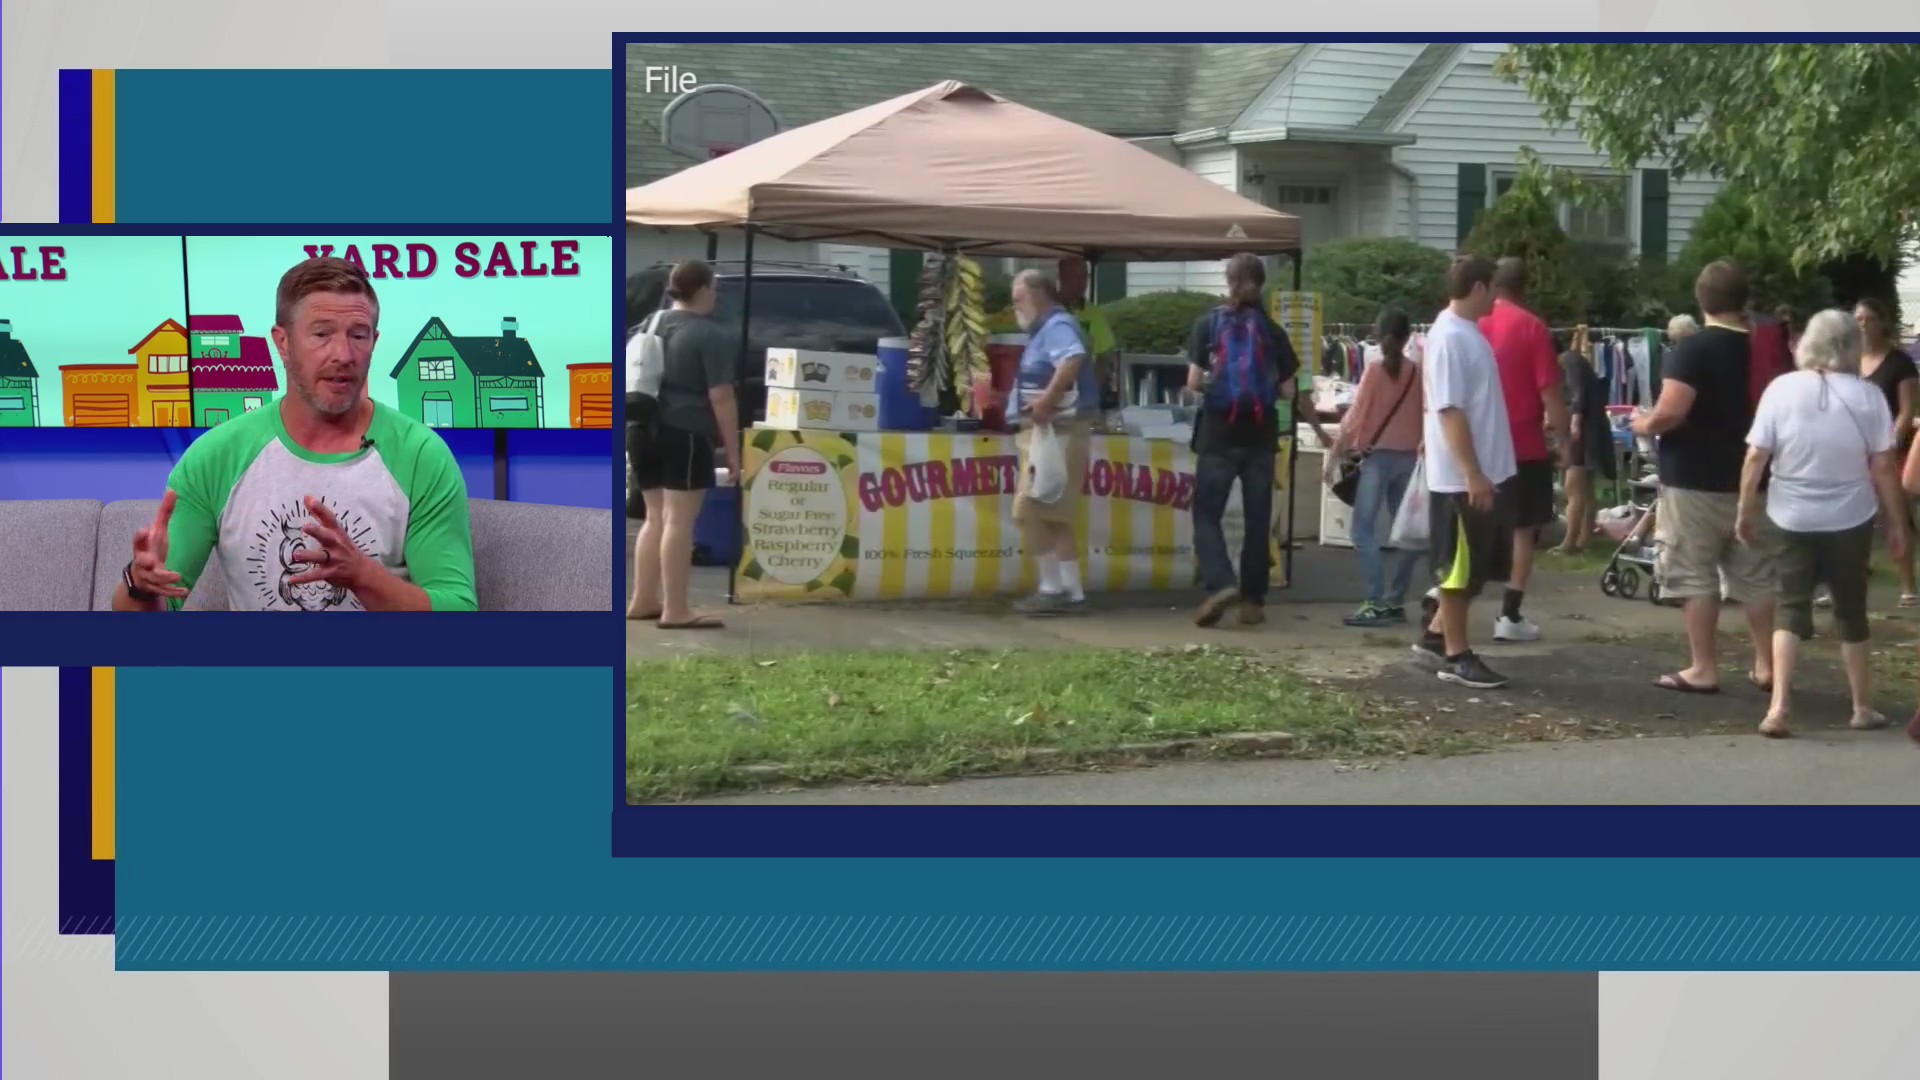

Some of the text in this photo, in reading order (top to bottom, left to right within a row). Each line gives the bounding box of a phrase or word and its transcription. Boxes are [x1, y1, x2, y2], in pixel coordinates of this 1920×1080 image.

[455, 240, 580, 278] SALE
[767, 479, 830, 493] Regular
[858, 455, 1018, 512] GOURMET
[789, 498, 805, 508] or
[758, 509, 836, 521] Sugar Free
[752, 523, 841, 538] Strawberry
[754, 539, 837, 553] Raspberry
[904, 548, 941, 559] Fresh
[944, 546, 1012, 560] Squeezed
[767, 555, 823, 569] Cherry
